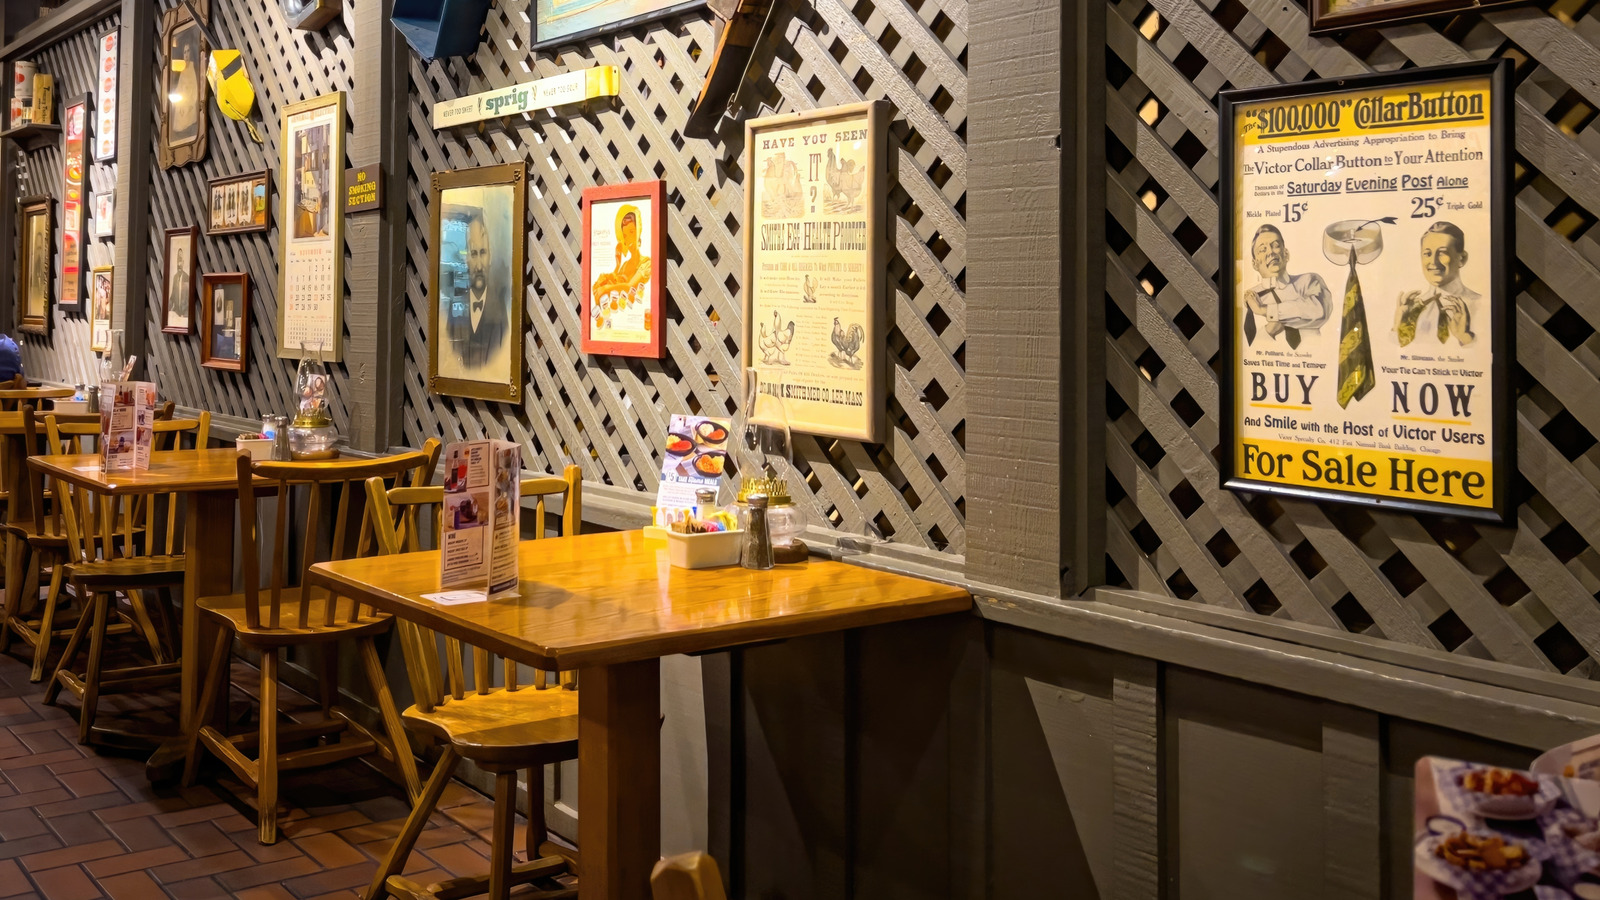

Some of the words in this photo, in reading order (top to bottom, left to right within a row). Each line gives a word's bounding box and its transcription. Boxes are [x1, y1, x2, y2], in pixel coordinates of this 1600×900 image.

[485, 88, 528, 115] sprig
[1244, 122, 1257, 133] The
[1354, 95, 1408, 129] Collar
[1407, 91, 1484, 120] Button
[762, 137, 794, 150] HAVE
[802, 134, 827, 146] YOU
[835, 129, 868, 142] SEEN
[1257, 146, 1264, 154] A
[1267, 142, 1310, 154] Stupendous
[1313, 138, 1359, 149] Advertising
[1363, 133, 1425, 146] Appropriation
[1441, 130, 1466, 139] Bring
[808, 153, 822, 182] IT
[1254, 161, 1292, 174] Victor
[1294, 157, 1334, 172] Collar
[1336, 155, 1382, 169] Button
[1394, 150, 1423, 165] Your
[1424, 147, 1483, 164] Attention
[348, 181, 376, 196] SMOKING
[357, 172, 366, 182] NO
[1286, 180, 1342, 194] Saturday
[1346, 176, 1398, 191] Evening
[1402, 174, 1433, 188] Post
[1436, 176, 1468, 186] Alone
[348, 192, 376, 206] SECTION
[1382, 366, 1399, 374] Your
[1400, 366, 1411, 374] Tie
[1432, 368, 1450, 376] Stick
[1460, 370, 1484, 378] Victor
[1251, 372, 1319, 404] BUY
[1391, 381, 1475, 418] NOW
[1244, 416, 1260, 427] And
[1264, 414, 1298, 430] Smile
[1300, 422, 1320, 432] with
[1324, 424, 1338, 434] the
[1343, 421, 1374, 436] Host
[1378, 428, 1388, 438] of
[1393, 424, 1436, 441] Victor
[1442, 428, 1485, 445] Users
[1242, 443, 1293, 478] For
[1302, 450, 1377, 488] Sale
[1388, 458, 1486, 500] Here
